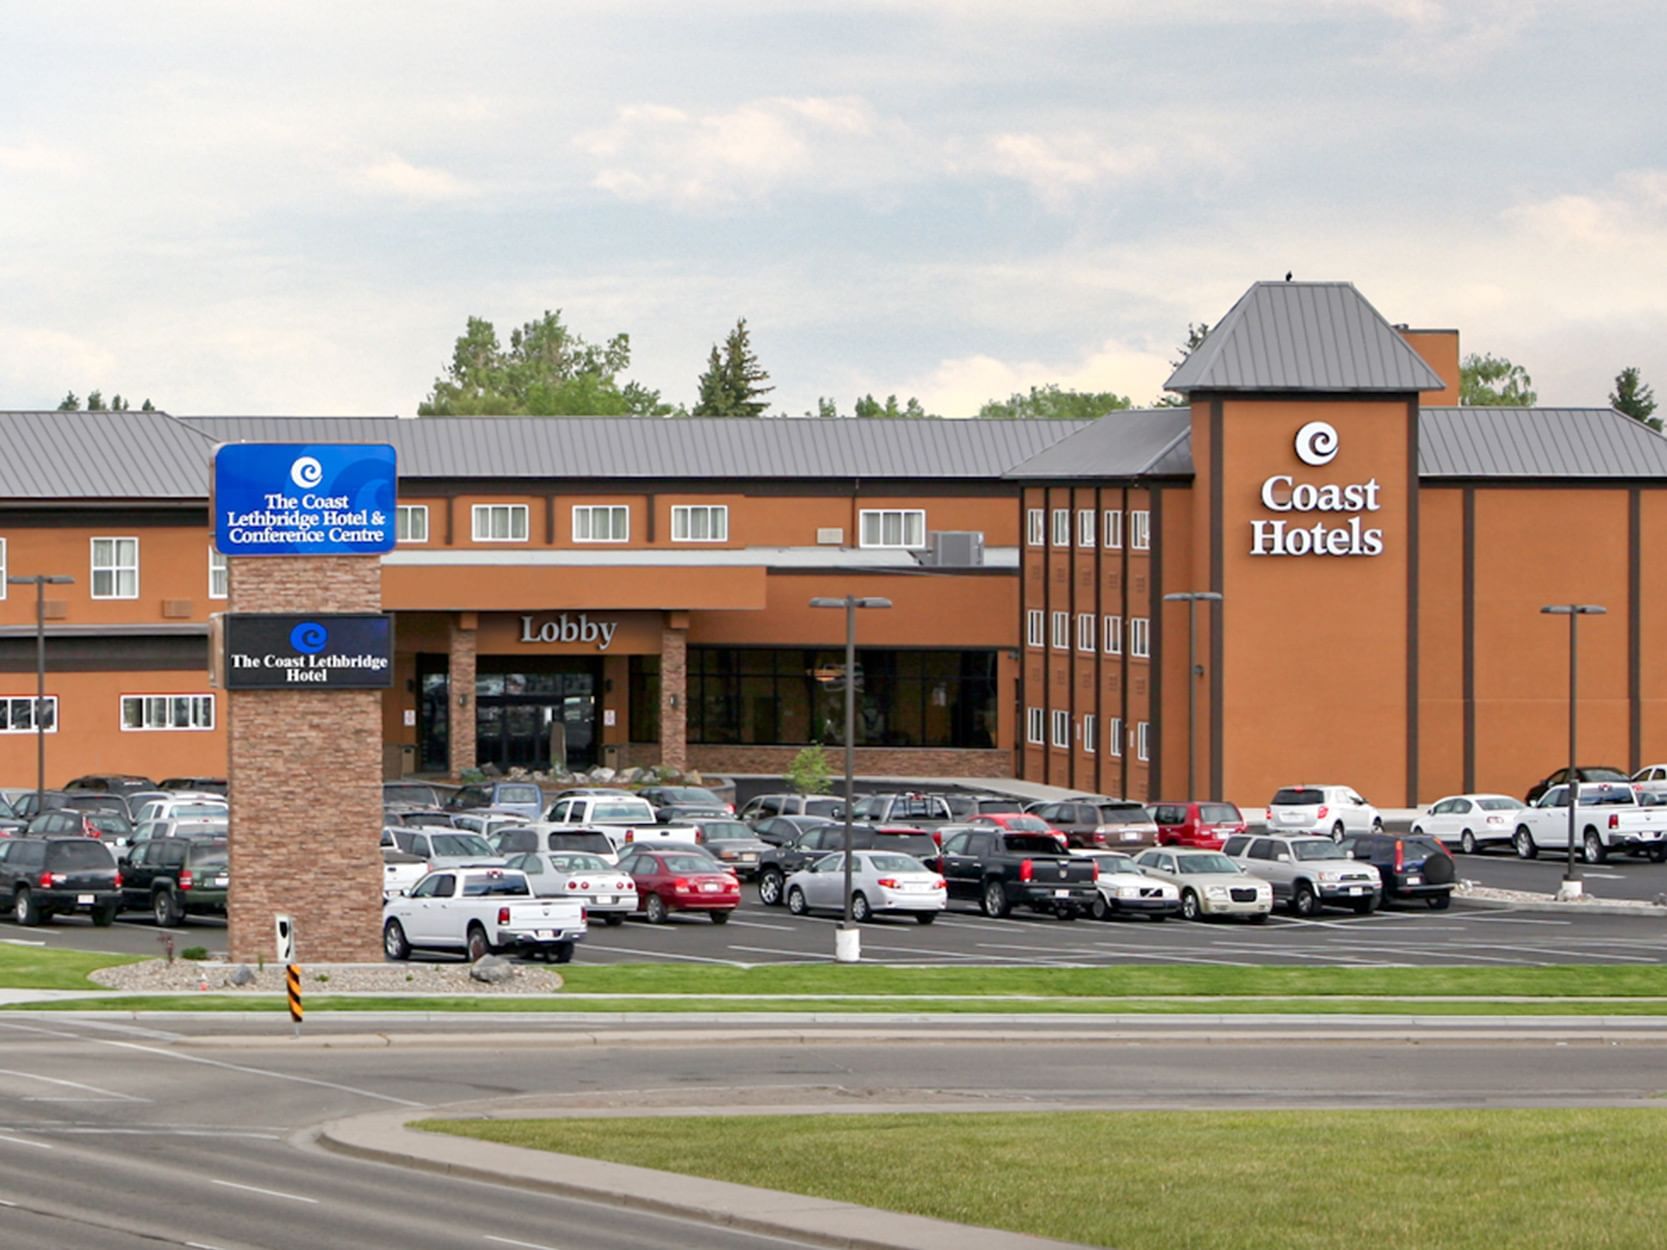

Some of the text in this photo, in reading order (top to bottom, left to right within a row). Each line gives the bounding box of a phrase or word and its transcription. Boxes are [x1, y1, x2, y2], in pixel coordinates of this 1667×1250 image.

[265, 494, 349, 510] The Coast
[1262, 475, 1381, 511] Coast
[227, 510, 385, 529] Lethbridge Hotel &
[229, 527, 385, 544] Conference Centre
[1249, 516, 1384, 556] Hotels
[521, 614, 617, 650] Lobby
[231, 654, 388, 670] The Coast Lethbridge
[286, 668, 328, 682] Hotel
